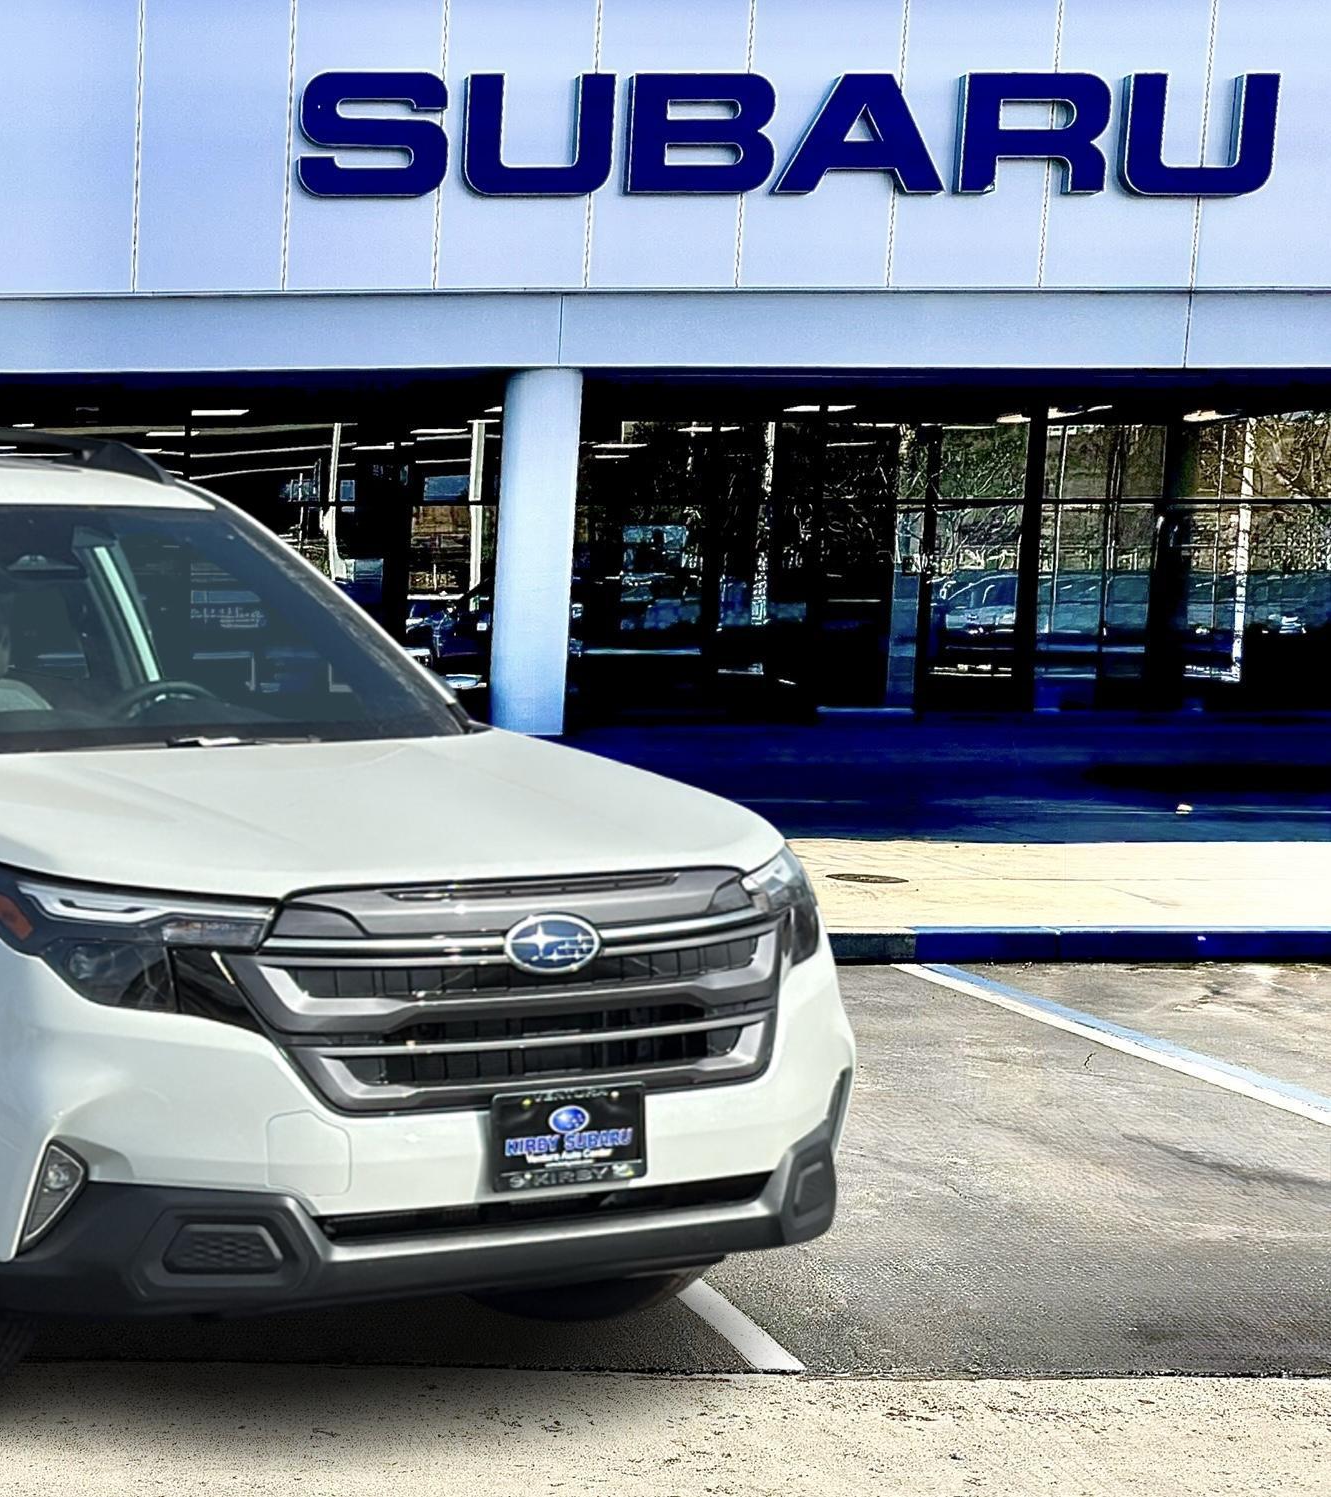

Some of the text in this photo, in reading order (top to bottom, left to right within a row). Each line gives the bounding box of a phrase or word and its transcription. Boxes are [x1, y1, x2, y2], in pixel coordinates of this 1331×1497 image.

[297, 71, 1281, 197] SUBARU
[505, 1127, 633, 1156] KIRBY SUBARU
[532, 1166, 609, 1187] KIRBY
